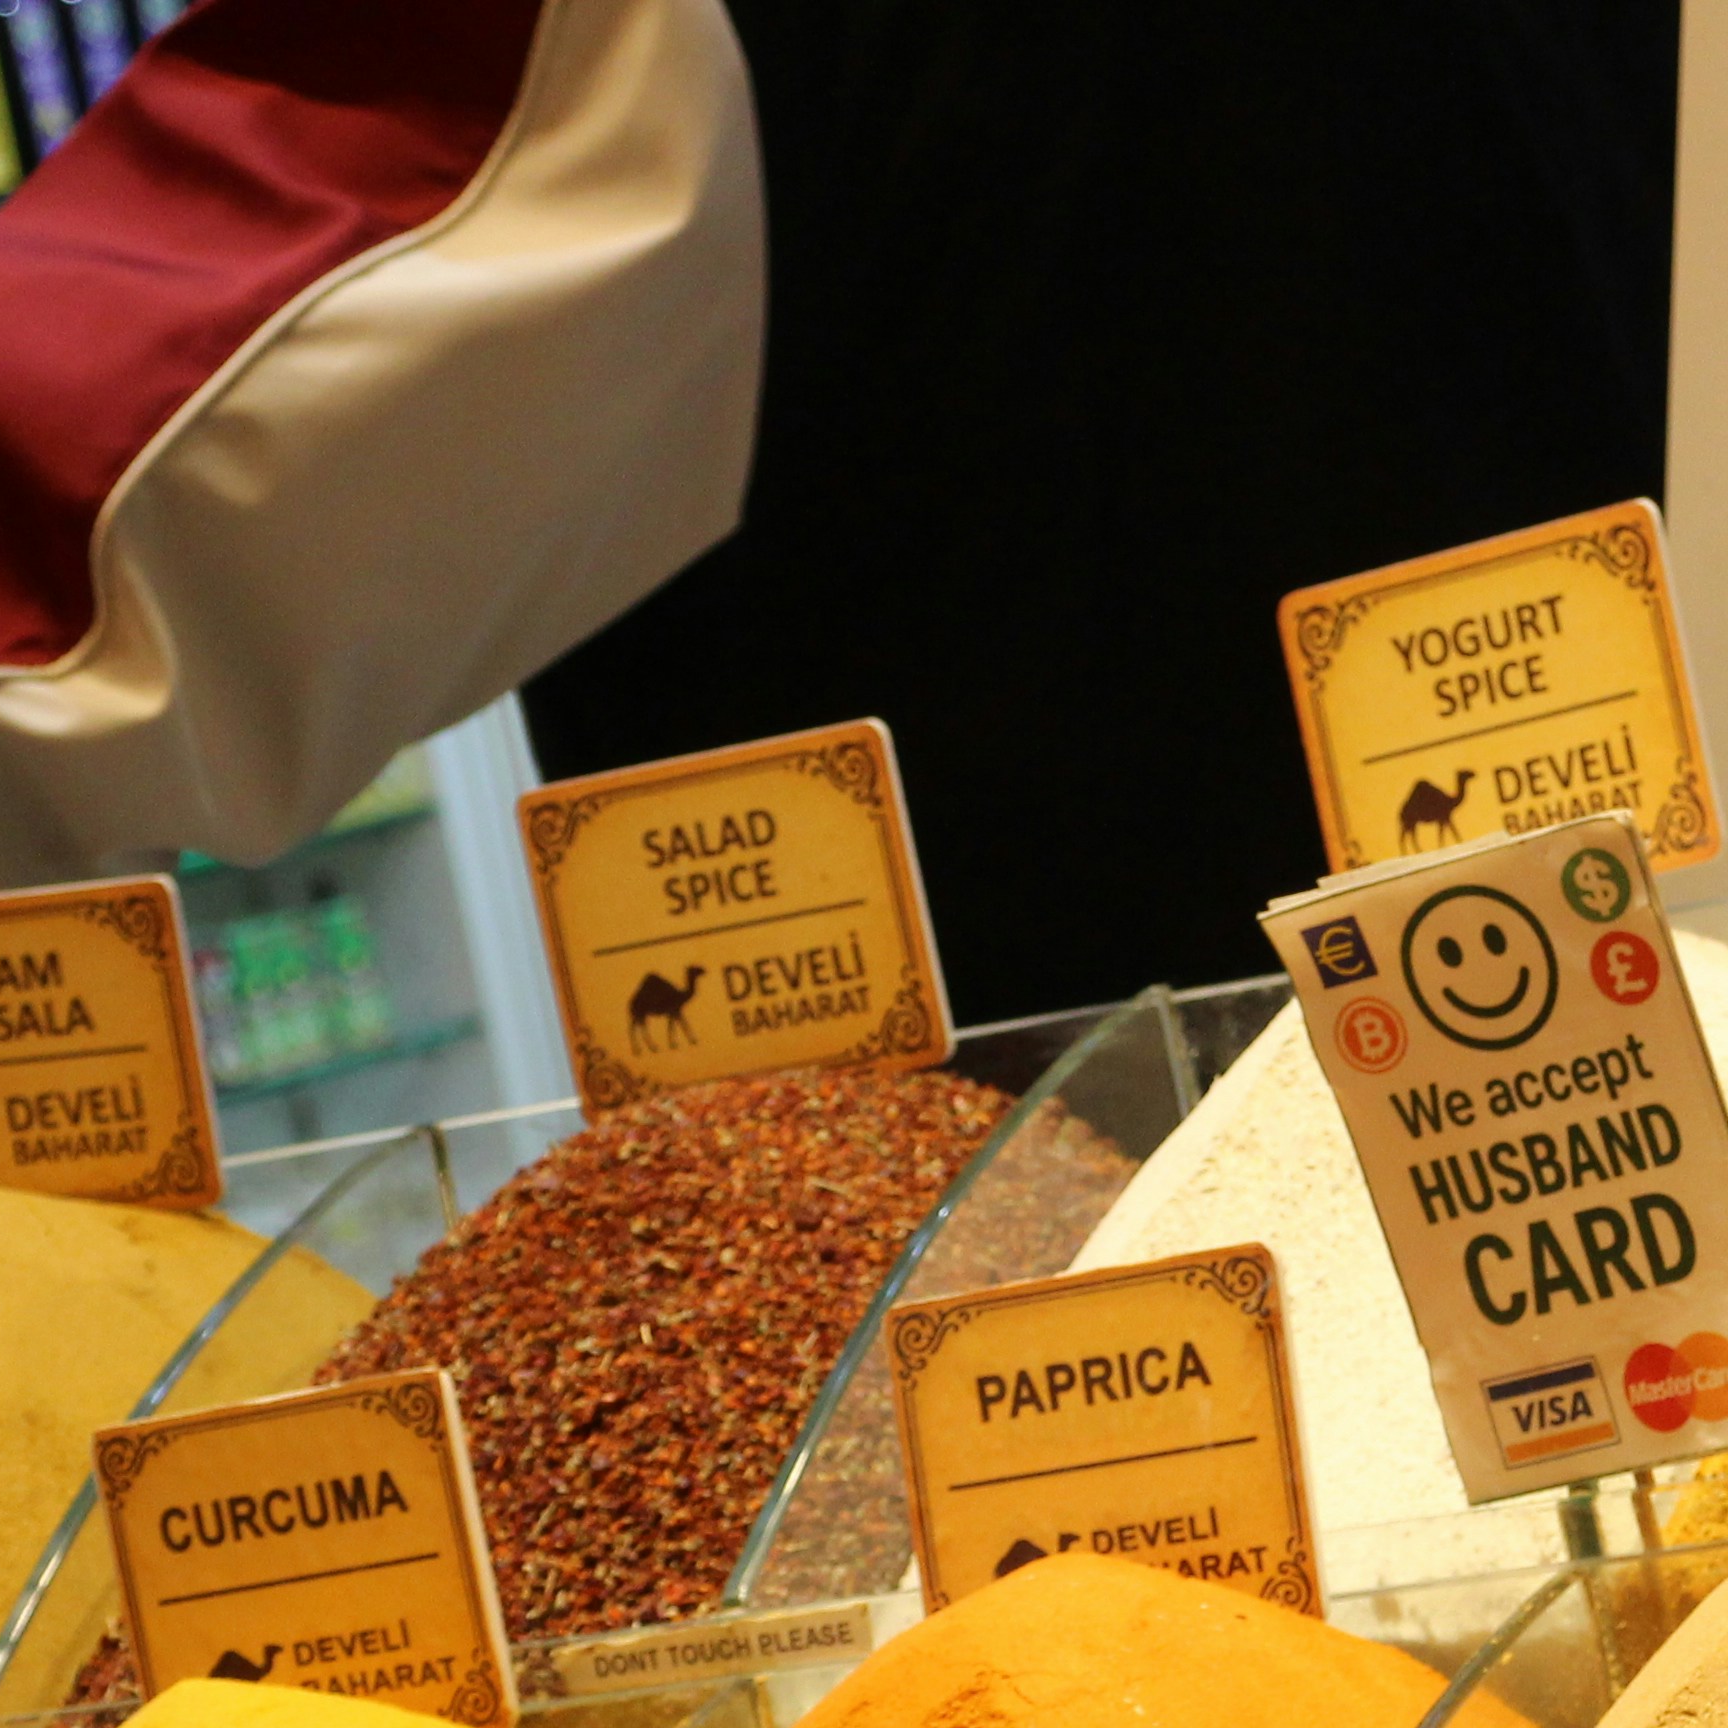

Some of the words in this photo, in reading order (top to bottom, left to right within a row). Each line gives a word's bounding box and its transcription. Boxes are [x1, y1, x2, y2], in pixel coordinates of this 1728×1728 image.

[1392, 596, 1565, 673] YOGURT
[1435, 655, 1547, 718] SPICE
[642, 808, 777, 869] SALAD
[664, 860, 777, 916] SPICE
[730, 987, 870, 1037] BAHARAT
[1389, 1082, 1475, 1141] We
[1485, 1034, 1653, 1119] accept
[11, 1126, 148, 1167] BAHARAT
[1409, 1103, 1682, 1226] HUSBAND
[1463, 1192, 1697, 1327] CARD
[975, 1341, 1212, 1423] PAPRICA
[1512, 1390, 1593, 1435] VISA
[159, 1469, 408, 1553] CURCUMA
[593, 1649, 660, 1678] DONT
[668, 1635, 752, 1667] TOUCH
[757, 1621, 854, 1657] PLEASE
